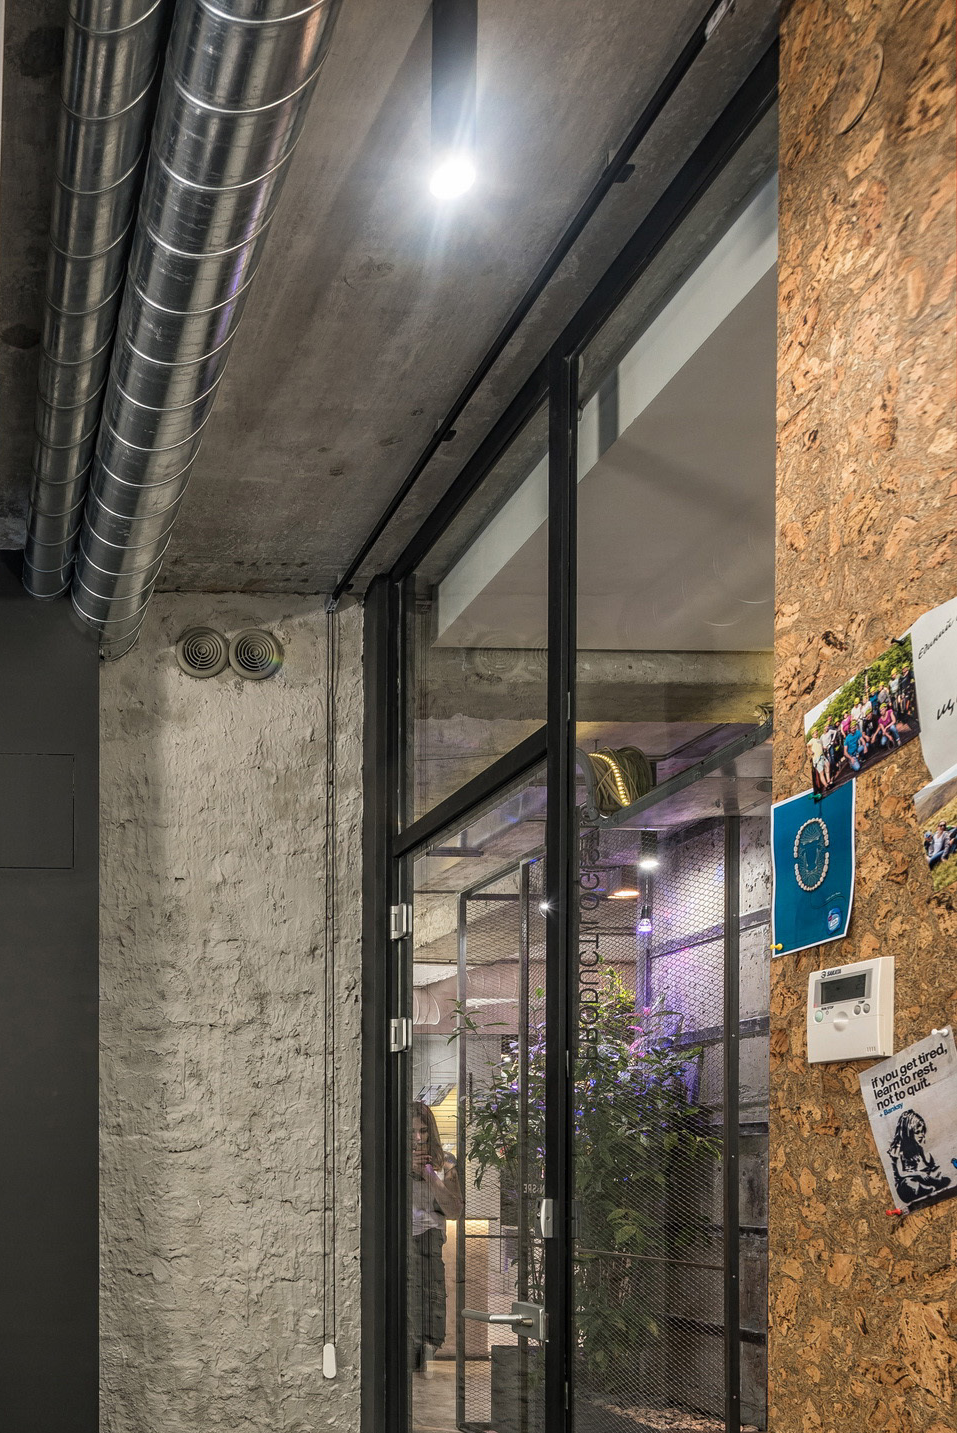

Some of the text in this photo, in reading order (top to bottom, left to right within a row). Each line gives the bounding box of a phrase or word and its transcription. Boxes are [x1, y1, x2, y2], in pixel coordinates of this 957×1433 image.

[871, 1043, 948, 1089] if you get tired,
[874, 1062, 938, 1100] learn to rest,
[877, 1078, 931, 1111] not to quit.
[883, 1102, 904, 1116] Banksy
